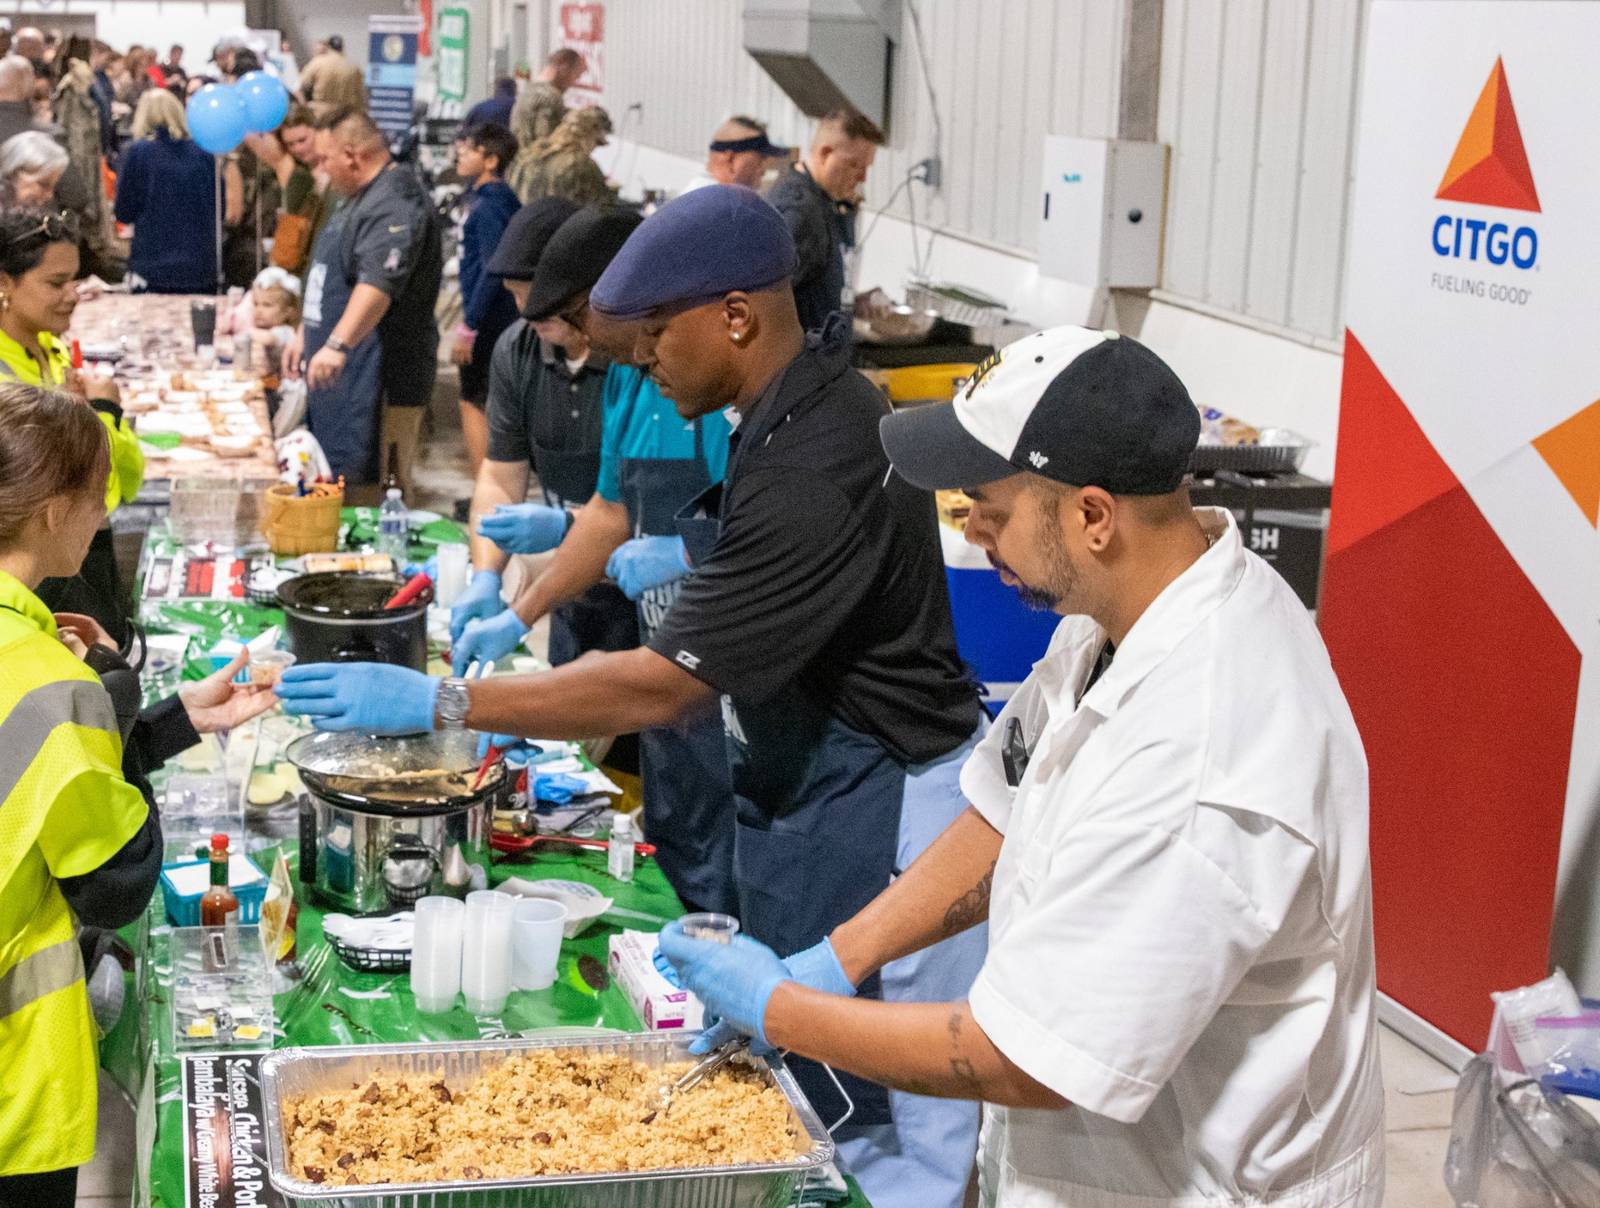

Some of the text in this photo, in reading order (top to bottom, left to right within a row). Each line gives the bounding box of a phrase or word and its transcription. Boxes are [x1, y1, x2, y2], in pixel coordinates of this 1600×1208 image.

[1432, 214, 1537, 270] CITGO
[1431, 272, 1485, 298] FUELING
[187, 1056, 223, 1117] Jambalaya
[198, 1163, 220, 1193] White
[232, 1166, 263, 1179] &
